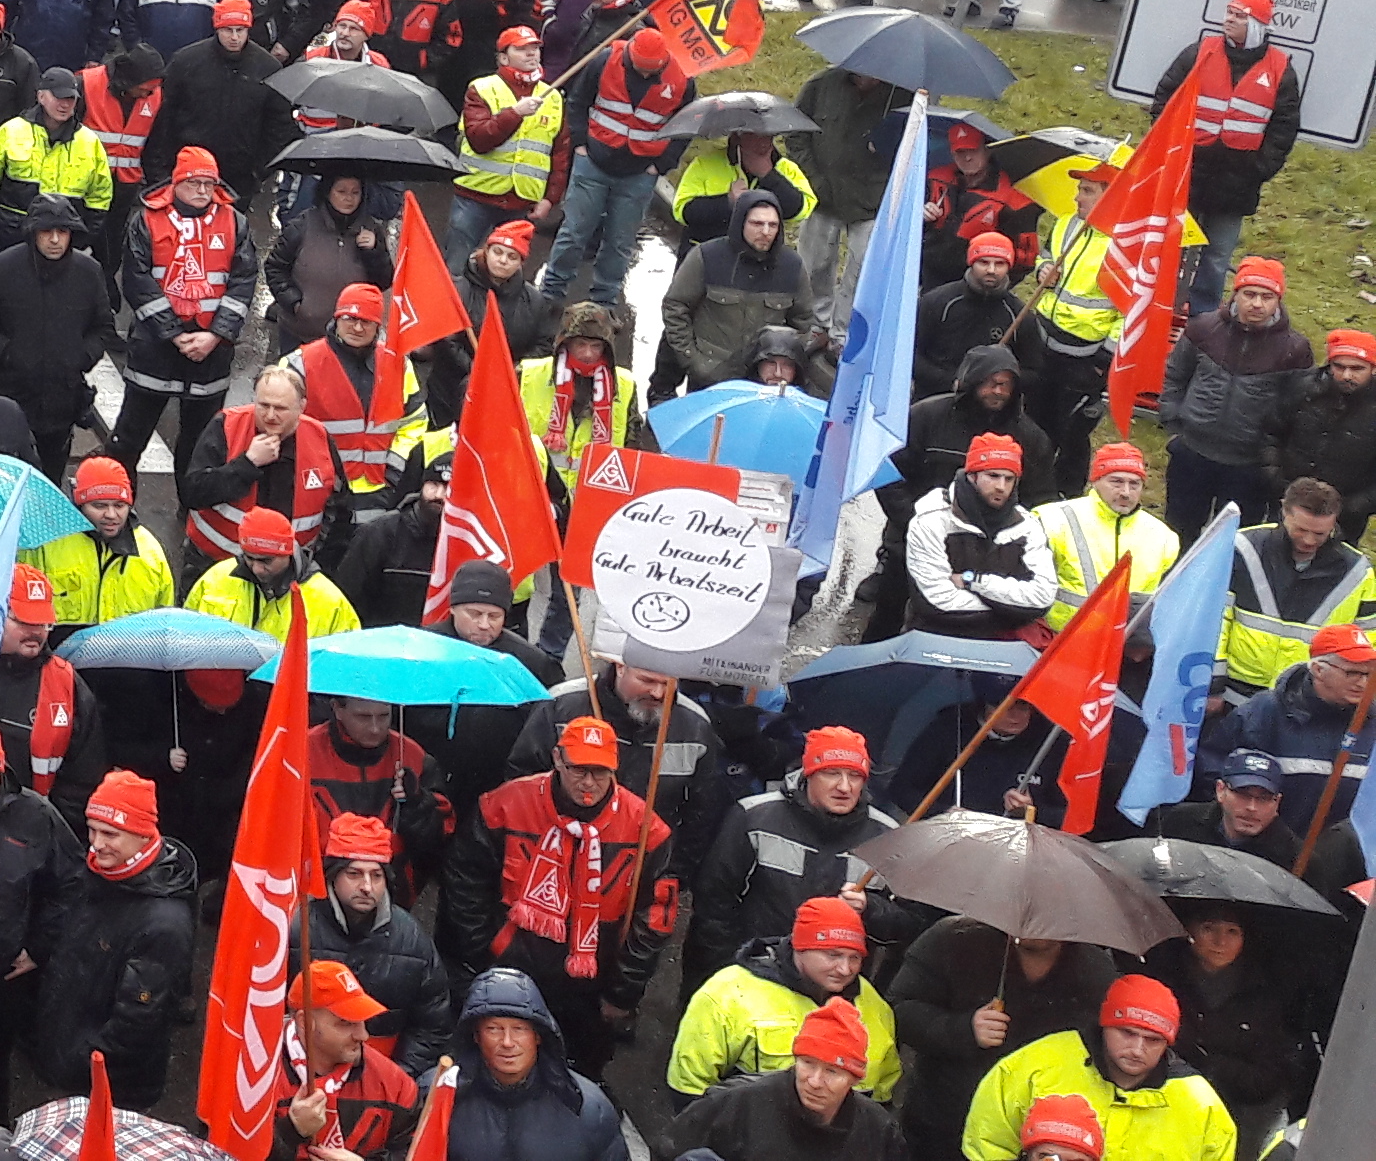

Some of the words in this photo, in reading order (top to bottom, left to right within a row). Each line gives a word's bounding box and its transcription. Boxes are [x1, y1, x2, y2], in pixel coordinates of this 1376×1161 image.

[667, 2, 687, 27] IG
[623, 501, 675, 526] Gute
[686, 510, 758, 548] Arbeit
[659, 539, 747, 570] braucht
[595, 552, 636, 573] Gute
[646, 561, 763, 603] Arbeitszeit
[1017, 773, 1041, 786] CM
